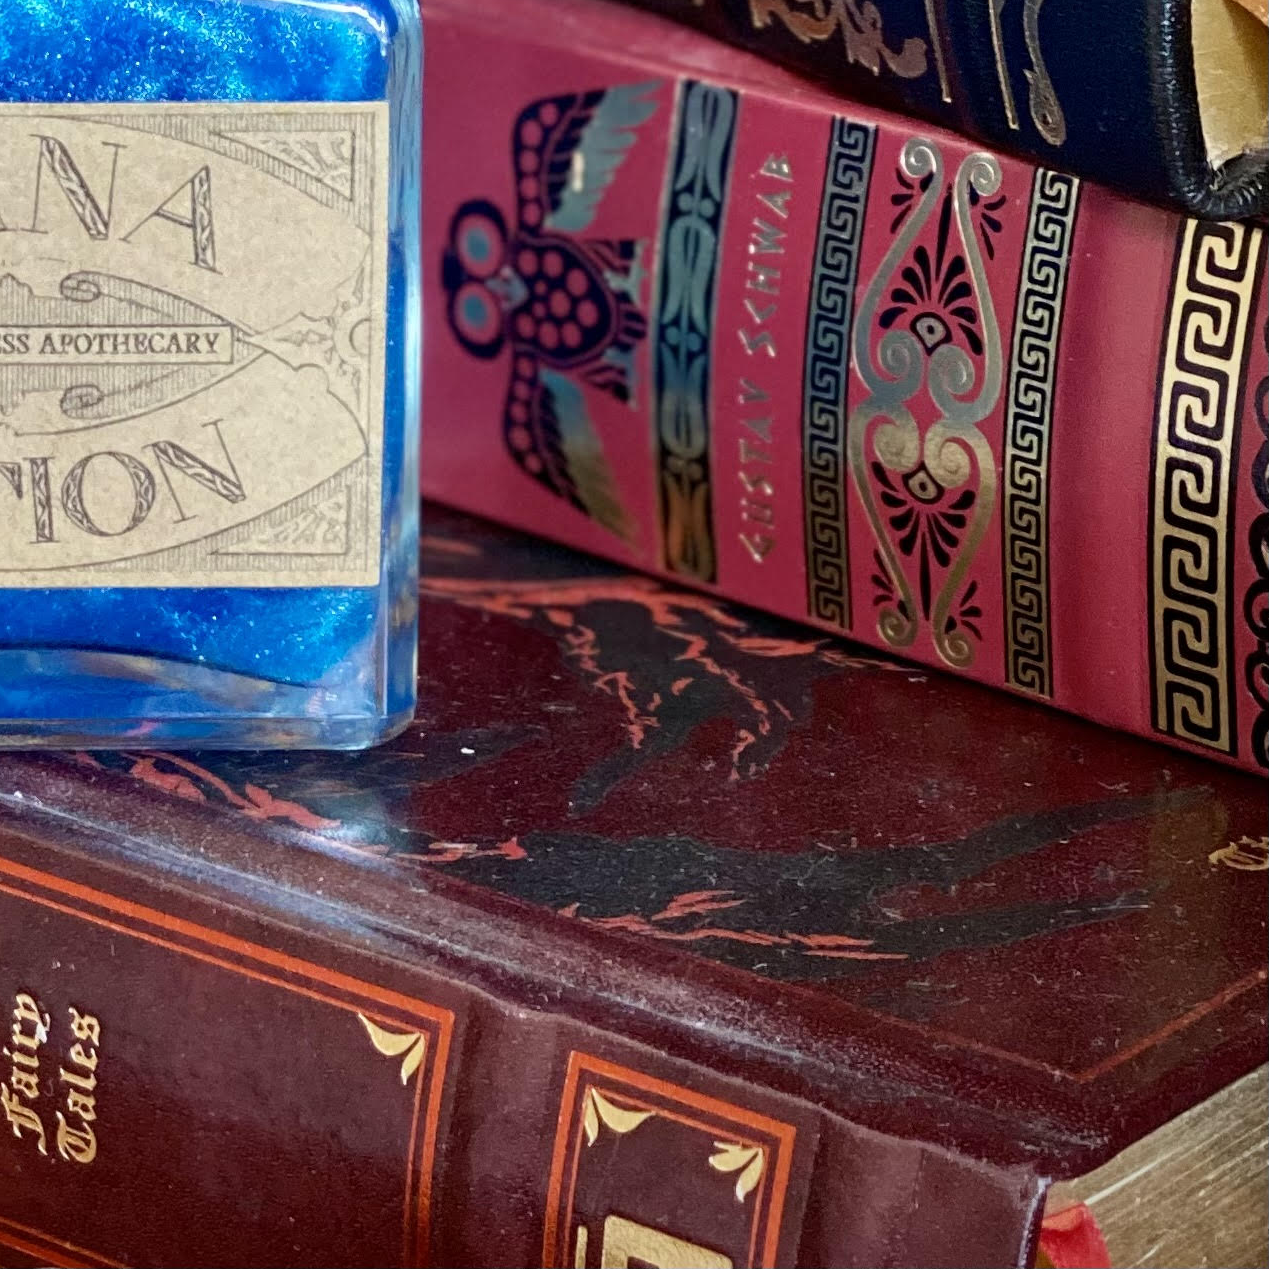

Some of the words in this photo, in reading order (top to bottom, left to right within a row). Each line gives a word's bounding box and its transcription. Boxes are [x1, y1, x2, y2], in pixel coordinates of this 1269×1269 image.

[738, 152, 794, 359] SCHWAB
[38, 332, 221, 355] APOTHECARY
[737, 378, 774, 562] GUSTAV
[0, 992, 51, 1157] Fairy
[56, 1006, 101, 1164] Tales
